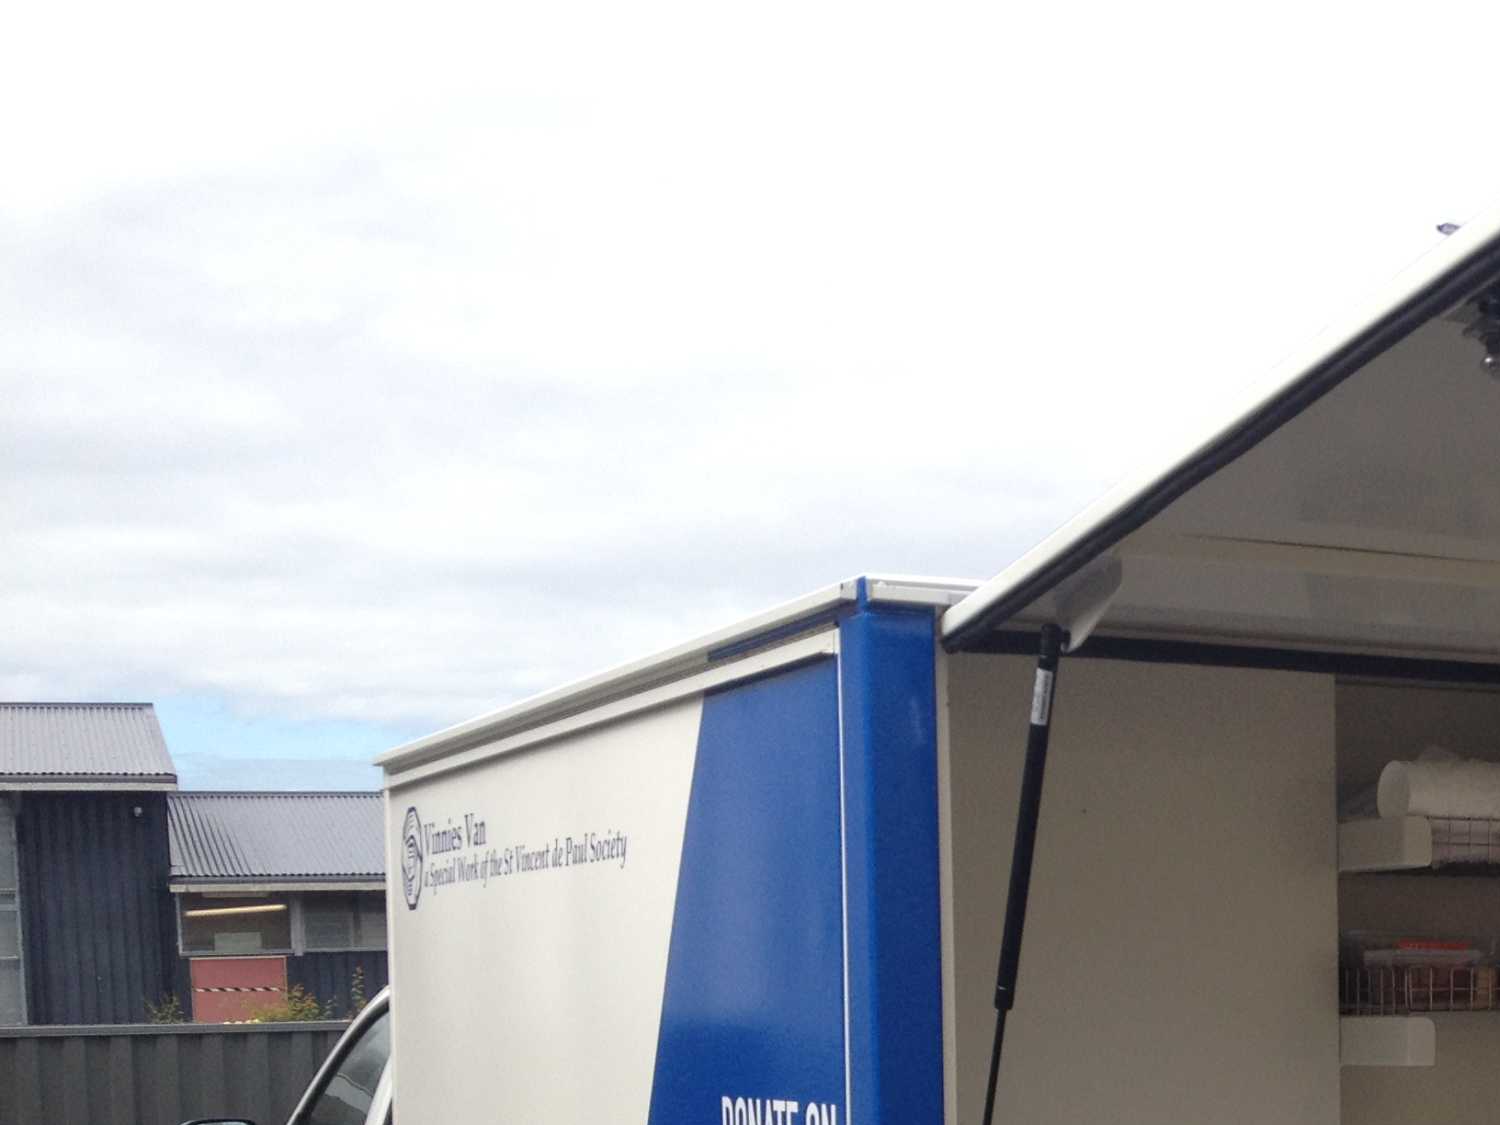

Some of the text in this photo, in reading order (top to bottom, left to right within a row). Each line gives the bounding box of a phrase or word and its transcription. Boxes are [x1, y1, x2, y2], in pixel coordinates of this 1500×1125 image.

[423, 812, 487, 857] Vinnies Van
[430, 856, 456, 897] Special
[456, 853, 479, 882] Work
[479, 849, 490, 889] of
[489, 848, 502, 877] the
[502, 846, 513, 876] St
[514, 842, 549, 873] Vincent
[551, 837, 563, 868] de
[564, 832, 588, 867] Paul
[589, 828, 628, 870] Society
